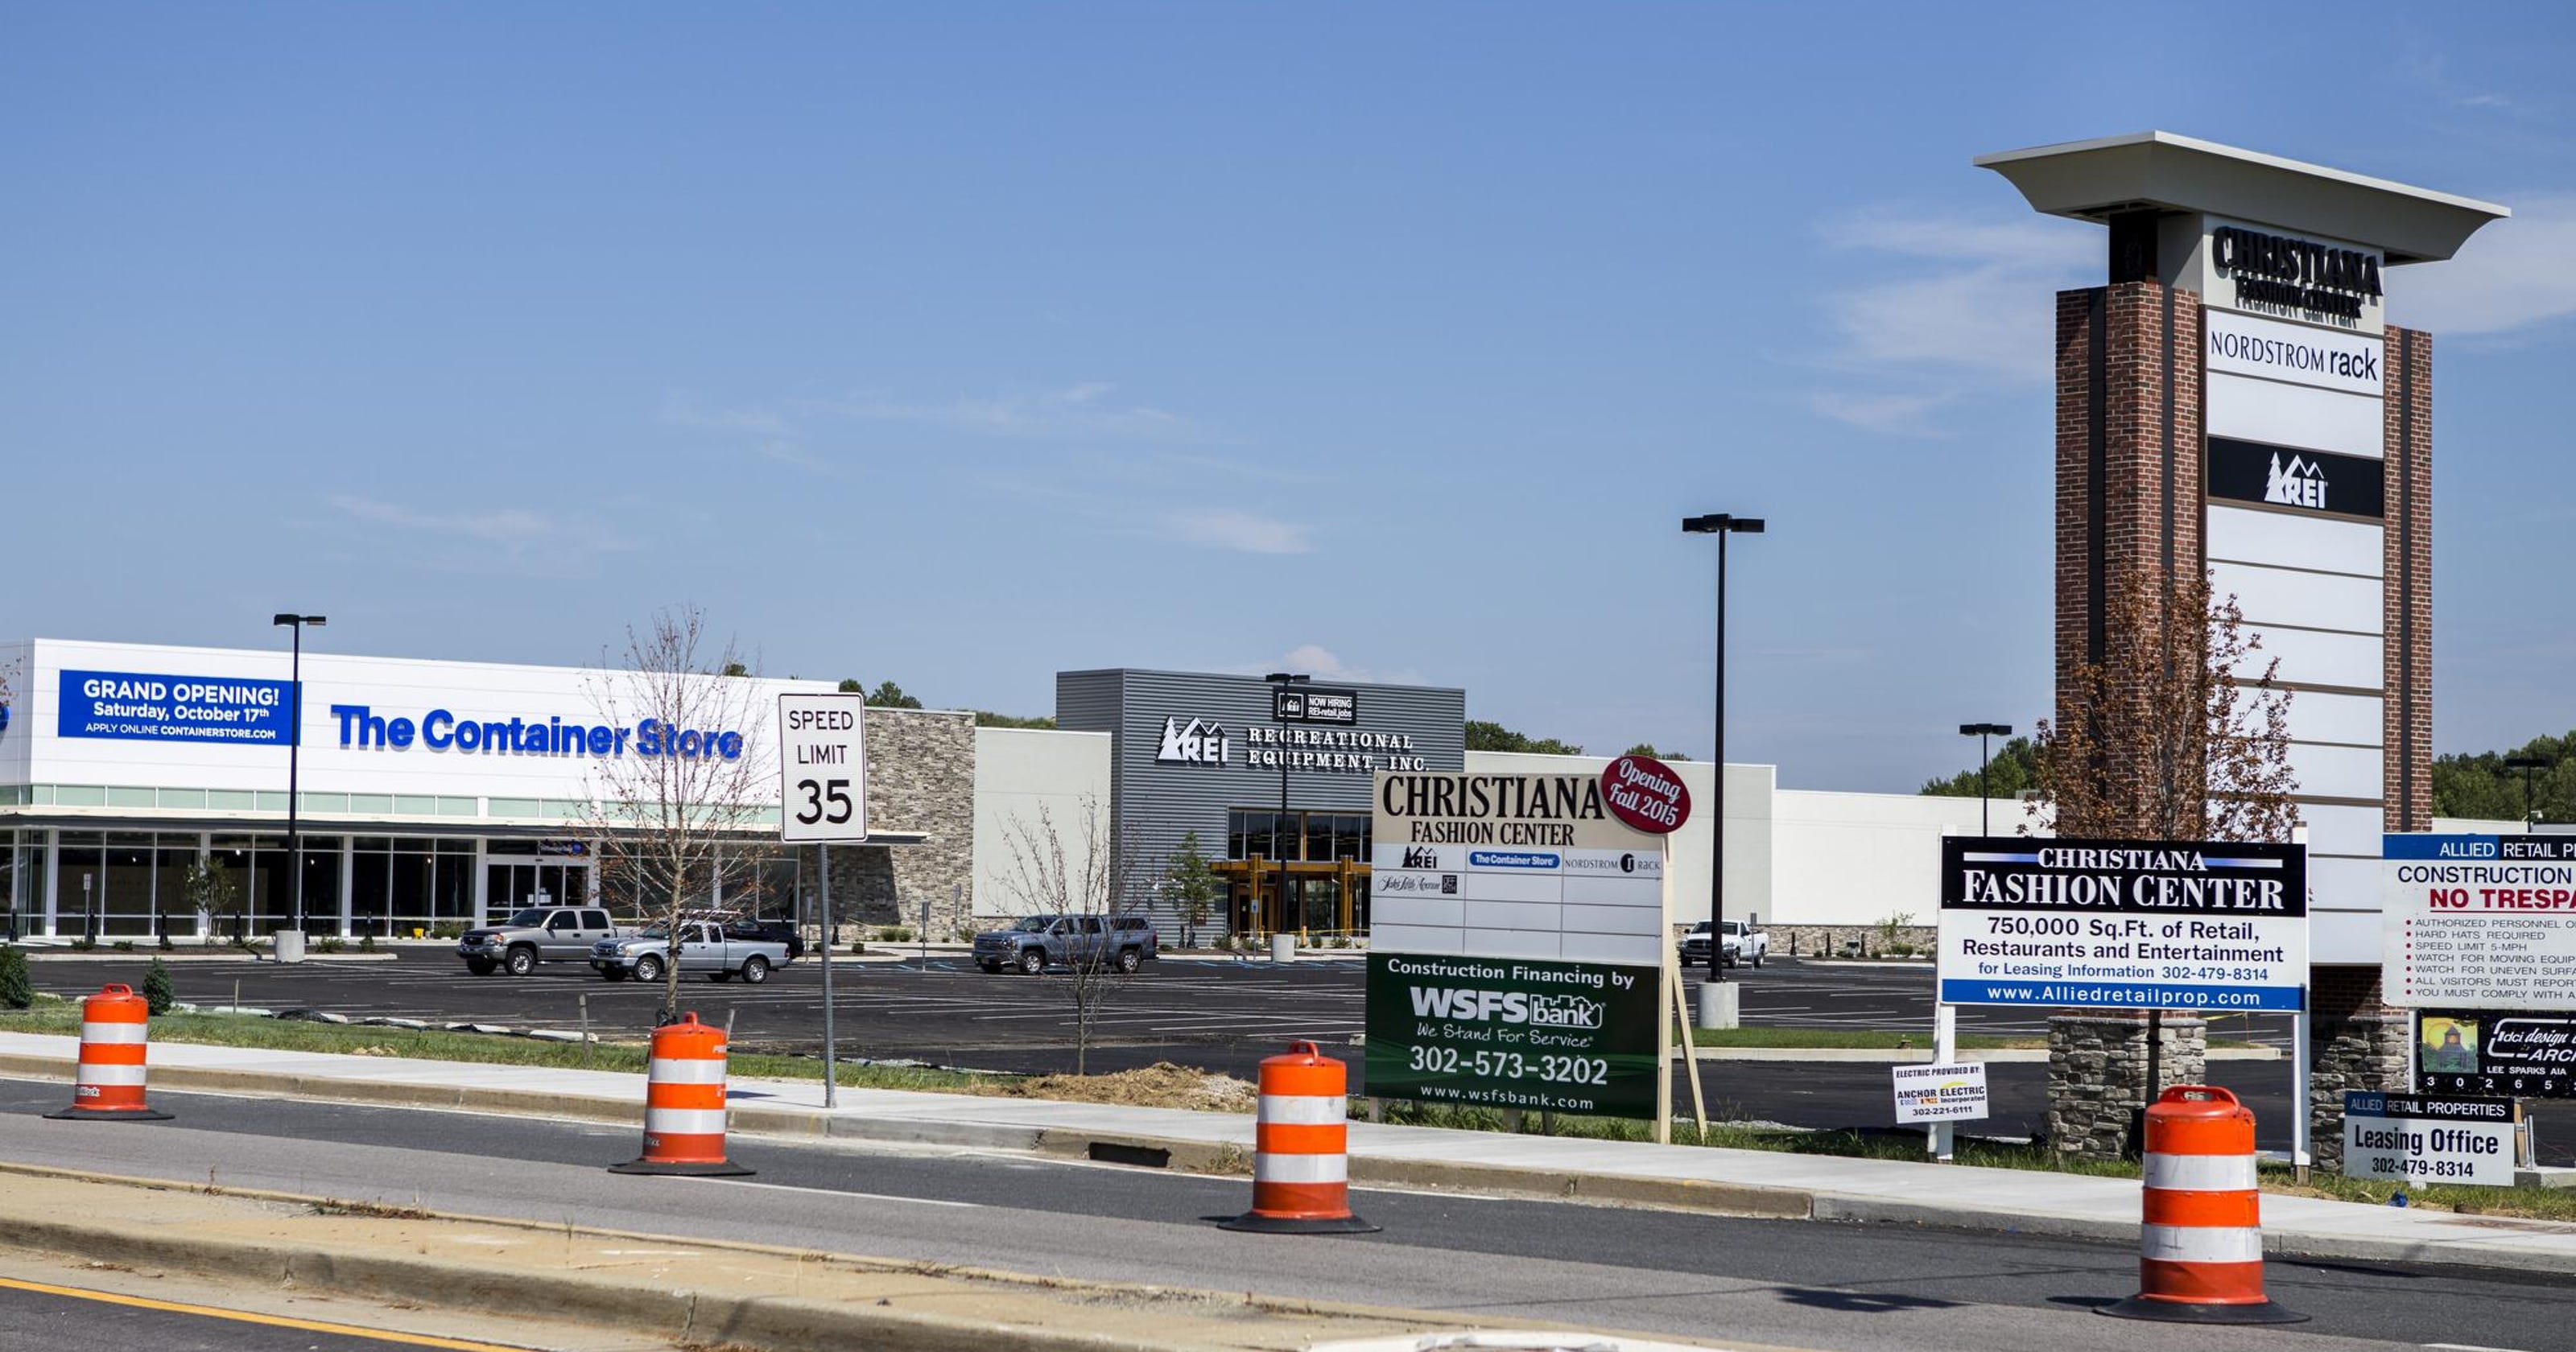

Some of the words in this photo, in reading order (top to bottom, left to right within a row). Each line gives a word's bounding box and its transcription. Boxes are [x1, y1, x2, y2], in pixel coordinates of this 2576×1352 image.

[2213, 226, 2383, 296] CHRISTIANA
[2211, 331, 2325, 372] NORDSTROM
[2330, 347, 2377, 381] rack
[2281, 476, 2326, 509] REI
[83, 679, 167, 700] GRAND
[173, 685, 279, 706] OPENING!
[1308, 697, 1327, 707] NOW
[1327, 699, 1352, 708] HIRING
[93, 702, 170, 721] Saturday,
[175, 705, 241, 722] October
[244, 707, 270, 723] 17th
[788, 711, 853, 731] SPEED
[85, 723, 118, 733] APPLY
[120, 724, 159, 735] ONLINE
[161, 726, 276, 740] CONTAINERSTORE.COM
[331, 705, 415, 748] The
[423, 709, 630, 755] Container
[637, 717, 744, 760] Store
[1249, 727, 1414, 750] RECREATIONAL
[797, 744, 847, 765] LIMIT
[1180, 736, 1229, 763] REI
[1249, 749, 1379, 772] EQUIPMENT,
[1389, 755, 1430, 772] INC.
[1619, 758, 1681, 804] Opening
[795, 778, 852, 825] 35
[1383, 775, 1606, 820] CHRISTIANA
[1609, 783, 1640, 810] Fall
[1639, 795, 1679, 826] 2015
[1411, 820, 1493, 844] FASHION
[1500, 823, 1575, 847] CENTER
[1475, 854, 1489, 864] The
[1489, 854, 1531, 866] Container
[1531, 855, 1554, 867] Store
[2037, 847, 2207, 872] CHRISTIANA
[2438, 843, 2496, 857] ALLIED
[2503, 843, 2557, 858] RETAIL
[2562, 843, 2576, 858] P
[1414, 855, 1437, 869] REI
[1565, 859, 1618, 869] NORDSTROM
[2397, 865, 2572, 884] CONSTRUCTION
[1963, 869, 2122, 905] FASHION
[2132, 874, 2285, 910] CENTER
[2429, 888, 2470, 909] NO
[1988, 916, 2079, 938] 750,000
[2089, 919, 2154, 941] Sq.Ft.
[2161, 921, 2184, 938] of
[2190, 921, 2260, 943] Retail,
[2415, 918, 2487, 928] AUTHORIZED
[2491, 919, 2562, 929] PERSONNEL
[2565, 920, 2576, 929] O
[2415, 930, 2447, 939] HARD
[2452, 930, 2480, 940] HATS
[2486, 931, 2546, 941] REQUIRED
[1963, 938, 2087, 958] Restaurants
[2093, 942, 2131, 959] and
[2138, 942, 2285, 963] Entertainment
[2415, 942, 2453, 950] SPEED
[2458, 942, 2486, 951] LIMIT
[2490, 942, 2528, 951] 5-MPH
[2415, 954, 2454, 962] WATCH
[2461, 954, 2485, 963] FOR
[2489, 954, 2536, 964] MOVING
[2540, 954, 2576, 964] EQUIP
[1388, 958, 1505, 980] Construction
[1513, 965, 1604, 988] Financing
[1612, 971, 1635, 990] by
[1978, 961, 1999, 975] for
[2004, 962, 2063, 979] Leasing
[2067, 964, 2155, 979] Information
[2162, 966, 2268, 981] 302-479-8314
[2415, 965, 2454, 975] WATCH
[2461, 966, 2485, 975] FOR
[2490, 967, 2537, 975] UNEVEN
[2415, 977, 2436, 986] ALL
[2440, 977, 2491, 987] VISITORS
[2496, 978, 2529, 987] MUST
[1987, 985, 2260, 1006] www.Alliedretailprop.com
[2415, 988, 2439, 998] YOU
[2444, 989, 2476, 998] MUST
[2481, 989, 2528, 999] COMPLY
[2533, 990, 2563, 999] WITH
[1410, 986, 1529, 1023] WSFS
[1533, 1000, 1592, 1026] bank
[1417, 1022, 1438, 1038] We
[1443, 1024, 1491, 1041] Stand
[1497, 1028, 1525, 1043] For
[1530, 1030, 1591, 1048] Service
[2524, 1027, 2570, 1047] design
[1410, 1045, 1608, 1086] 302-573-3202
[1896, 1069, 1930, 1078] ELECTRIC
[1931, 1067, 1967, 1076] PROVIDED
[2486, 1066, 2504, 1074] LEE
[2508, 1066, 2546, 1075] SPARKS
[2549, 1067, 2567, 1075] AIA
[1420, 1086, 1594, 1111] www.wsfsbank.com
[1897, 1089, 1937, 1099] ANCHOR
[1939, 1086, 1985, 1097] ELECTRIC
[1940, 1095, 1986, 1103] Incorporated
[1912, 1106, 1973, 1116] 302-221-6111
[2350, 1098, 2384, 1111] ALLIED
[2387, 1100, 2423, 1114] RETAIL
[2427, 1102, 2506, 1117] PROPERTIES
[2355, 1124, 2423, 1156] Leasing
[2430, 1128, 2499, 1155] Office
[2372, 1157, 2474, 1177] 302-479-8314
